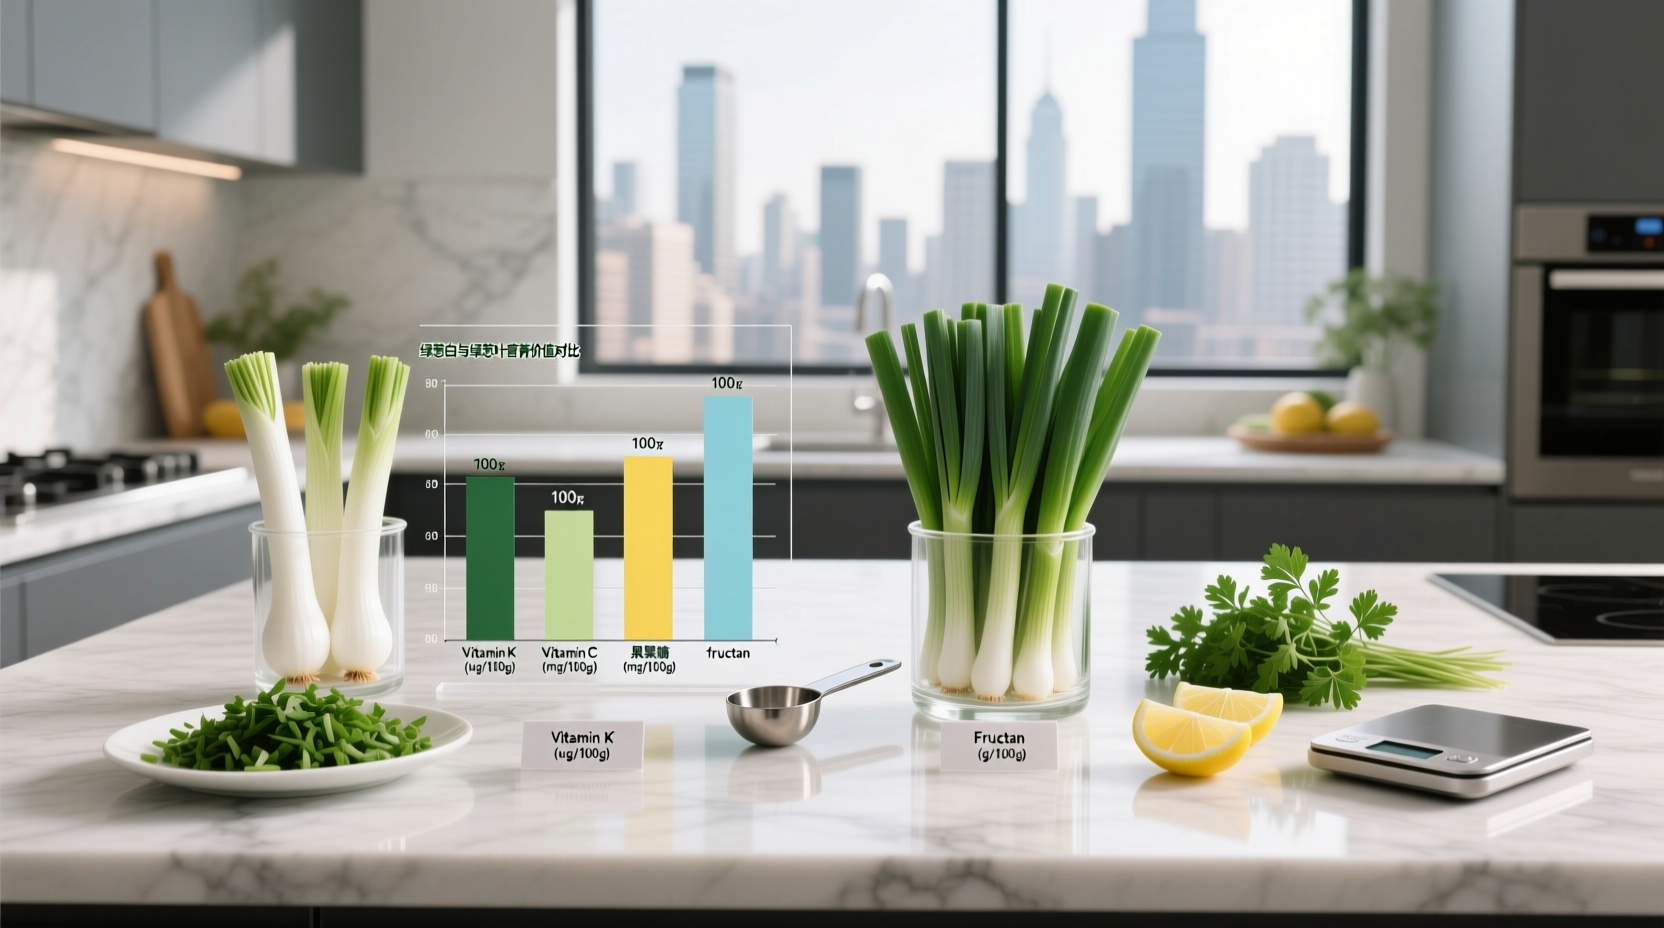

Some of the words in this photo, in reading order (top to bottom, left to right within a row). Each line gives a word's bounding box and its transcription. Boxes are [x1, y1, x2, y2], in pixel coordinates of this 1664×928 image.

[461, 646, 506, 659] Vitamin
[507, 646, 517, 659] K
[541, 646, 586, 659] Vitamin
[587, 646, 598, 659] C
[706, 646, 751, 659] fructan
[623, 661, 676, 675] (mg/100g)
[551, 731, 601, 744] Vitamin
[604, 731, 615, 744] K
[974, 731, 1025, 744] Fructan
[554, 747, 610, 762] (ug/100g)
[978, 748, 1027, 762] (g/100g)
